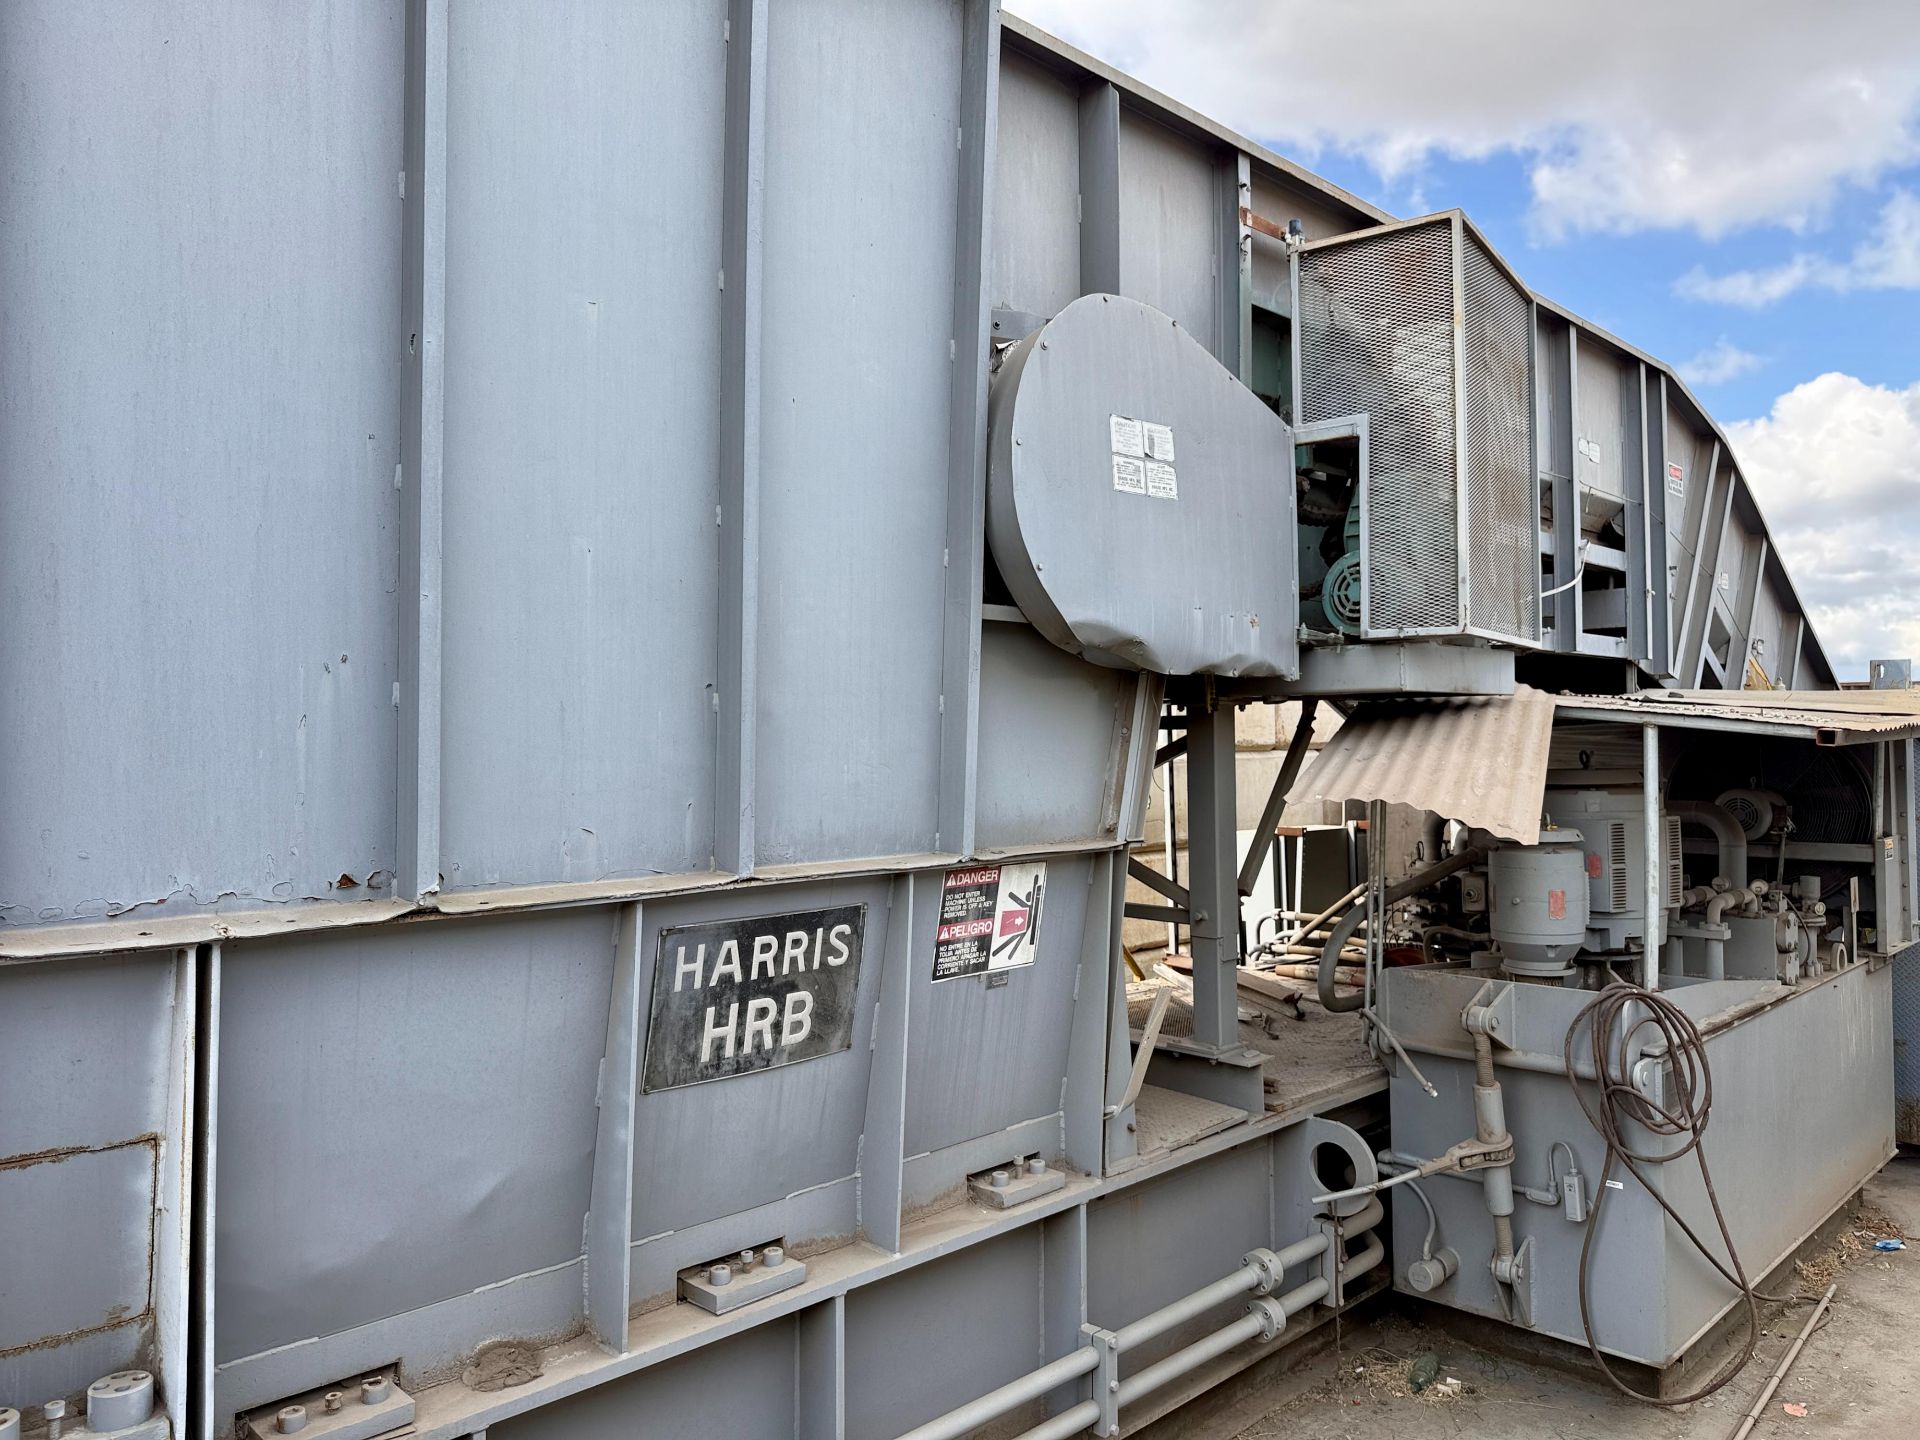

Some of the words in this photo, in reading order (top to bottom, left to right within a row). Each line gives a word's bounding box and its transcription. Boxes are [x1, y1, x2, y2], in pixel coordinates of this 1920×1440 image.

[957, 870, 999, 885] DANGER
[950, 921, 992, 938] PELIGRO
[673, 923, 852, 993] HARRIS
[937, 960, 964, 970] CORRIENTE
[701, 990, 814, 1062] HRB
